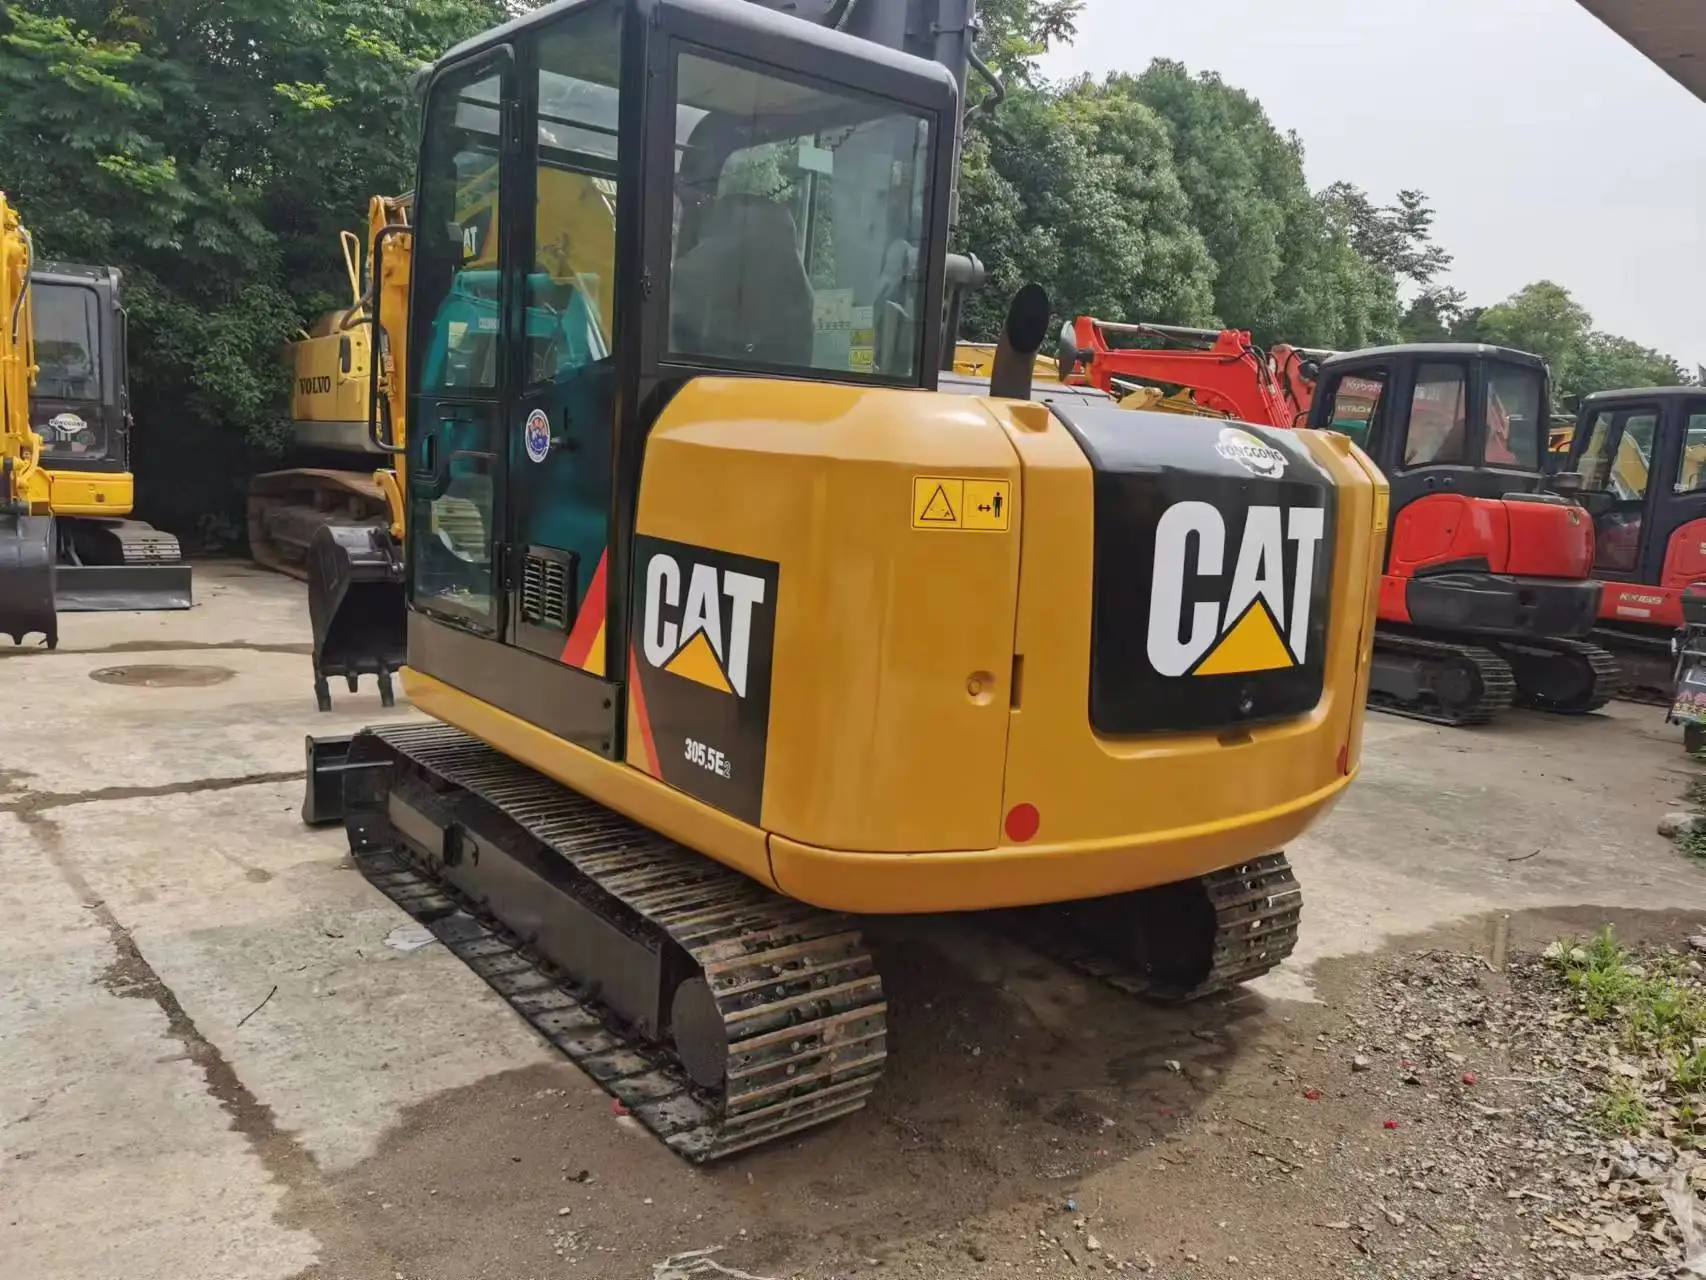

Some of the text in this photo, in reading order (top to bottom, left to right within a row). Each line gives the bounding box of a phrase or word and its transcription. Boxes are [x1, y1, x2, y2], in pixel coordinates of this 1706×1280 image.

[463, 226, 478, 256] AT
[299, 376, 331, 394] VOLVO
[644, 553, 766, 698] CAT
[1147, 501, 1325, 676] CAT
